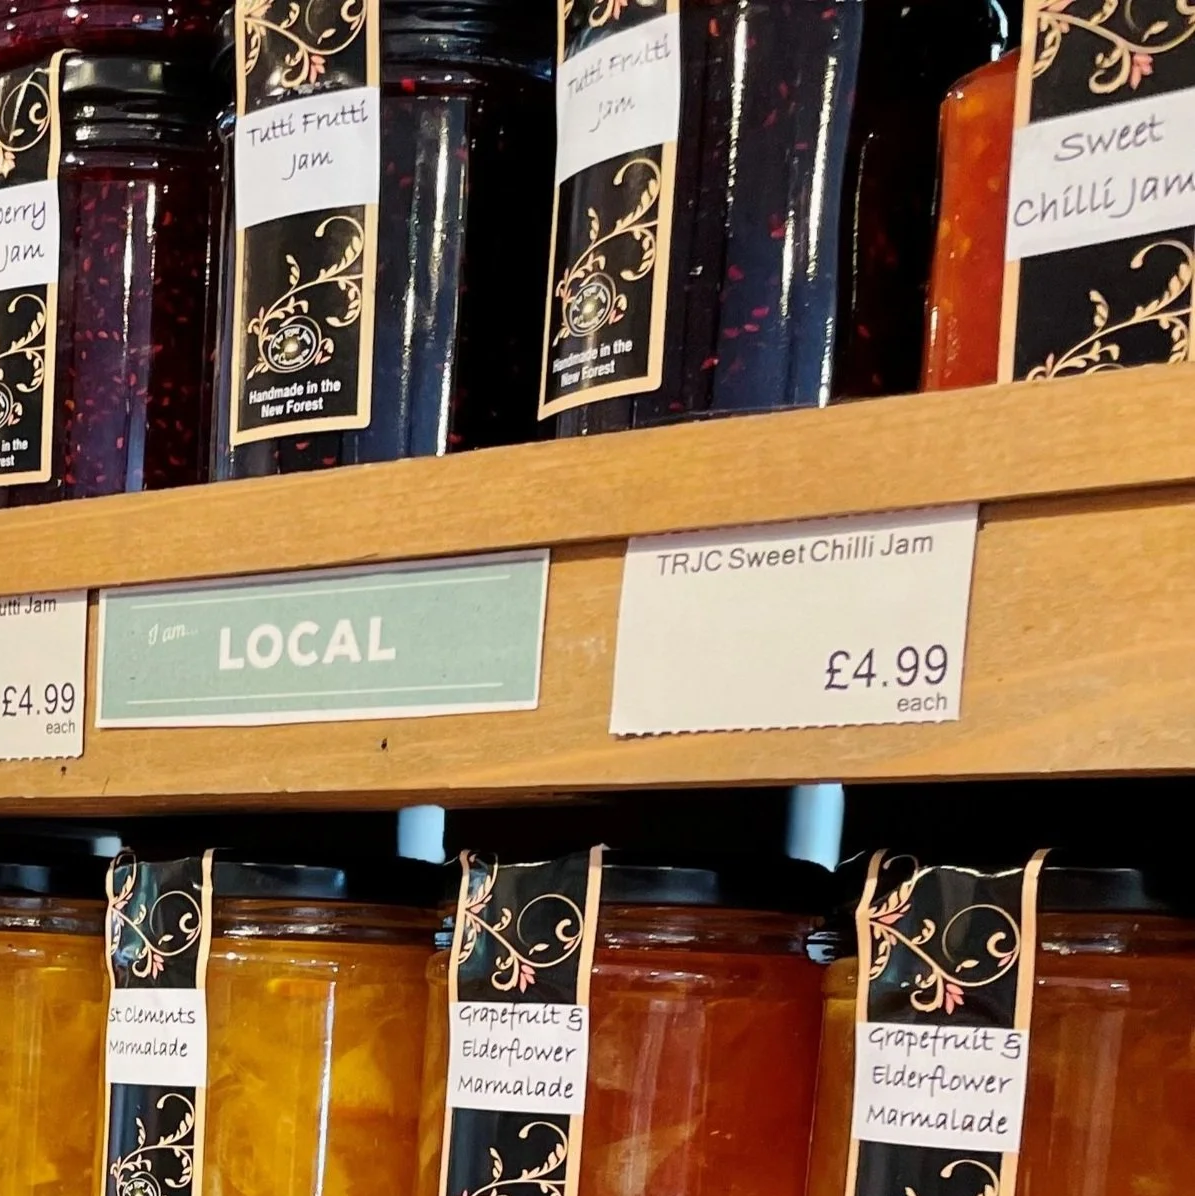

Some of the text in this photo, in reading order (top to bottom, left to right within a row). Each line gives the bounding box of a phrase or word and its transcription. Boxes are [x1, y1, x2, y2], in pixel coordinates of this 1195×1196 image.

[246, 99, 369, 147] Tutti Frutti
[1054, 113, 1167, 162] Sweet
[281, 151, 334, 181] Jam
[1013, 171, 1195, 227] Chilli Jam
[600, 343, 611, 357] in
[613, 338, 633, 354] the
[581, 359, 615, 381] Forest
[249, 378, 342, 404] Handmade in the
[261, 397, 324, 418] New Forest
[12, 438, 29, 451] the
[657, 533, 934, 576] TRJC Sweet Chilli Jam
[24, 596, 58, 615] Jam
[218, 615, 397, 672] LOCAL
[824, 644, 949, 691] £4.99
[1, 682, 76, 717] £4.99
[896, 692, 948, 713] each
[46, 720, 76, 735] each
[459, 1002, 583, 1032] Grapefruit &
[462, 1037, 577, 1068] Elderflower
[868, 1025, 1022, 1060] Grapefruit &
[457, 1074, 574, 1099] Marmalade
[872, 1063, 1013, 1098] Elderflower
[866, 1104, 1009, 1134] Marmalade
